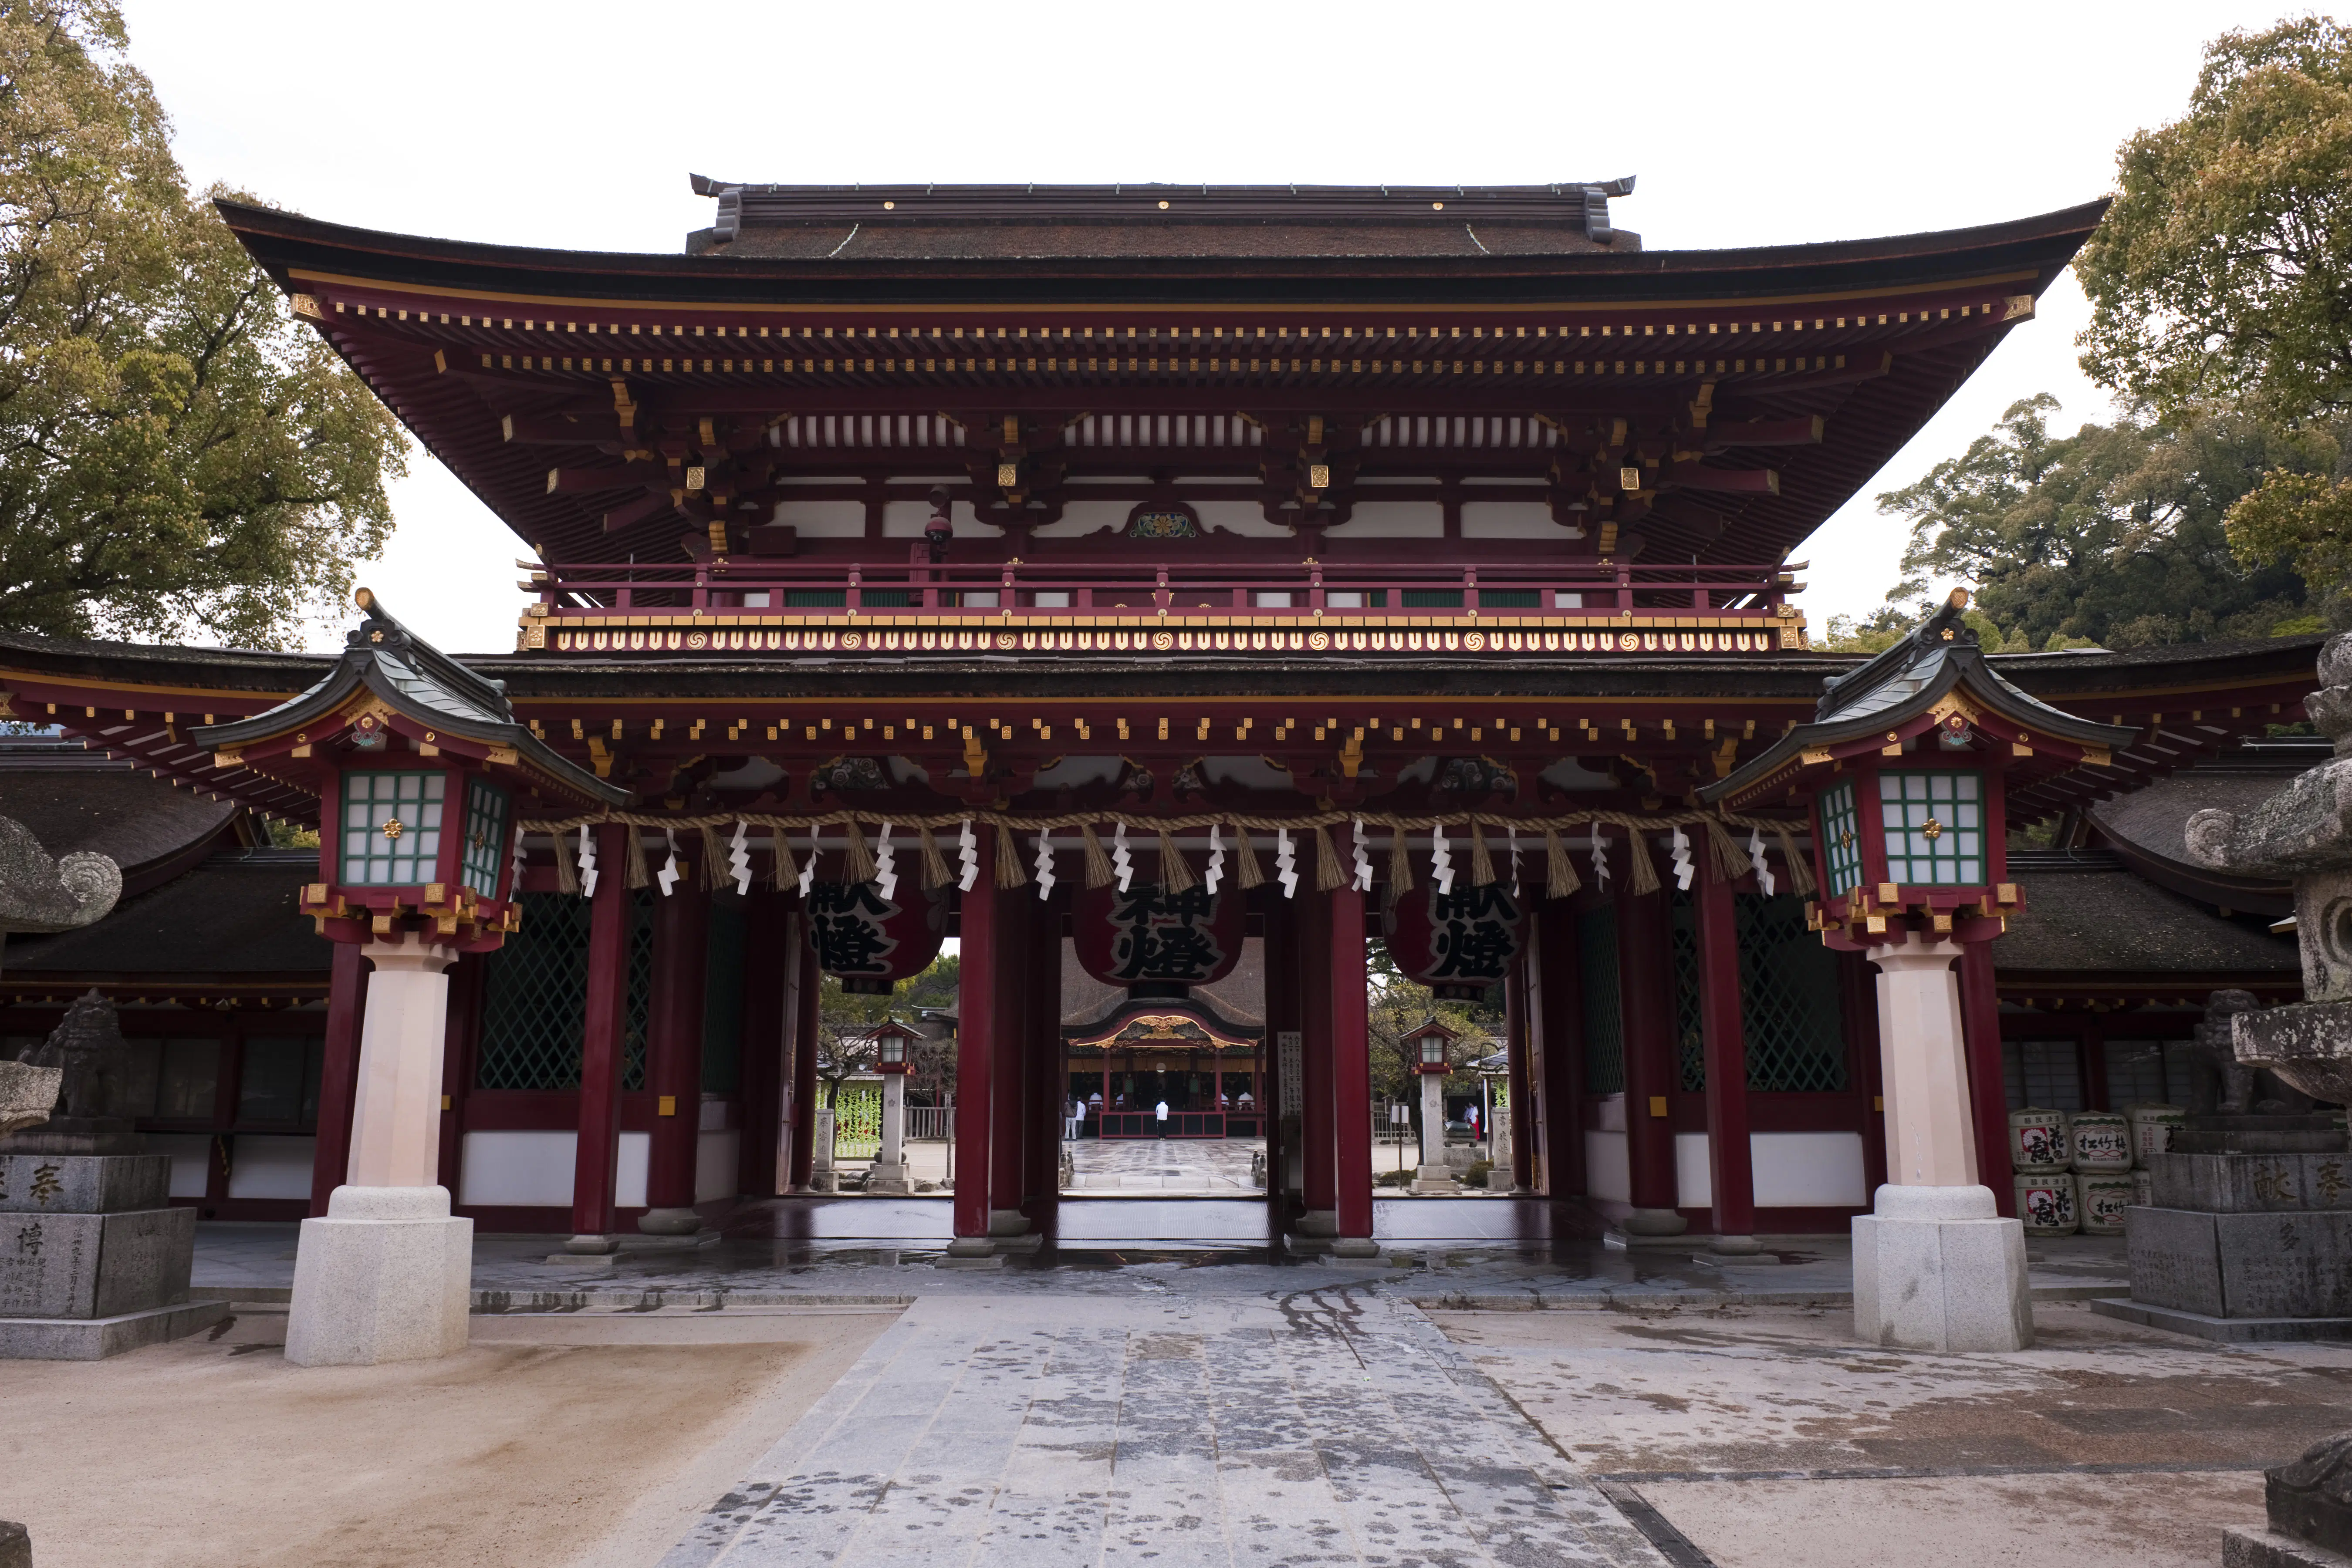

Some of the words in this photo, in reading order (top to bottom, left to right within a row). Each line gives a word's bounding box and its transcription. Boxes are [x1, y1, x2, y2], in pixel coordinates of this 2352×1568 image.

[1114, 881, 1218, 979] 神燈
[2078, 1134, 2127, 1150] 松竹梅
[2096, 1198, 2132, 1214] 松竹
